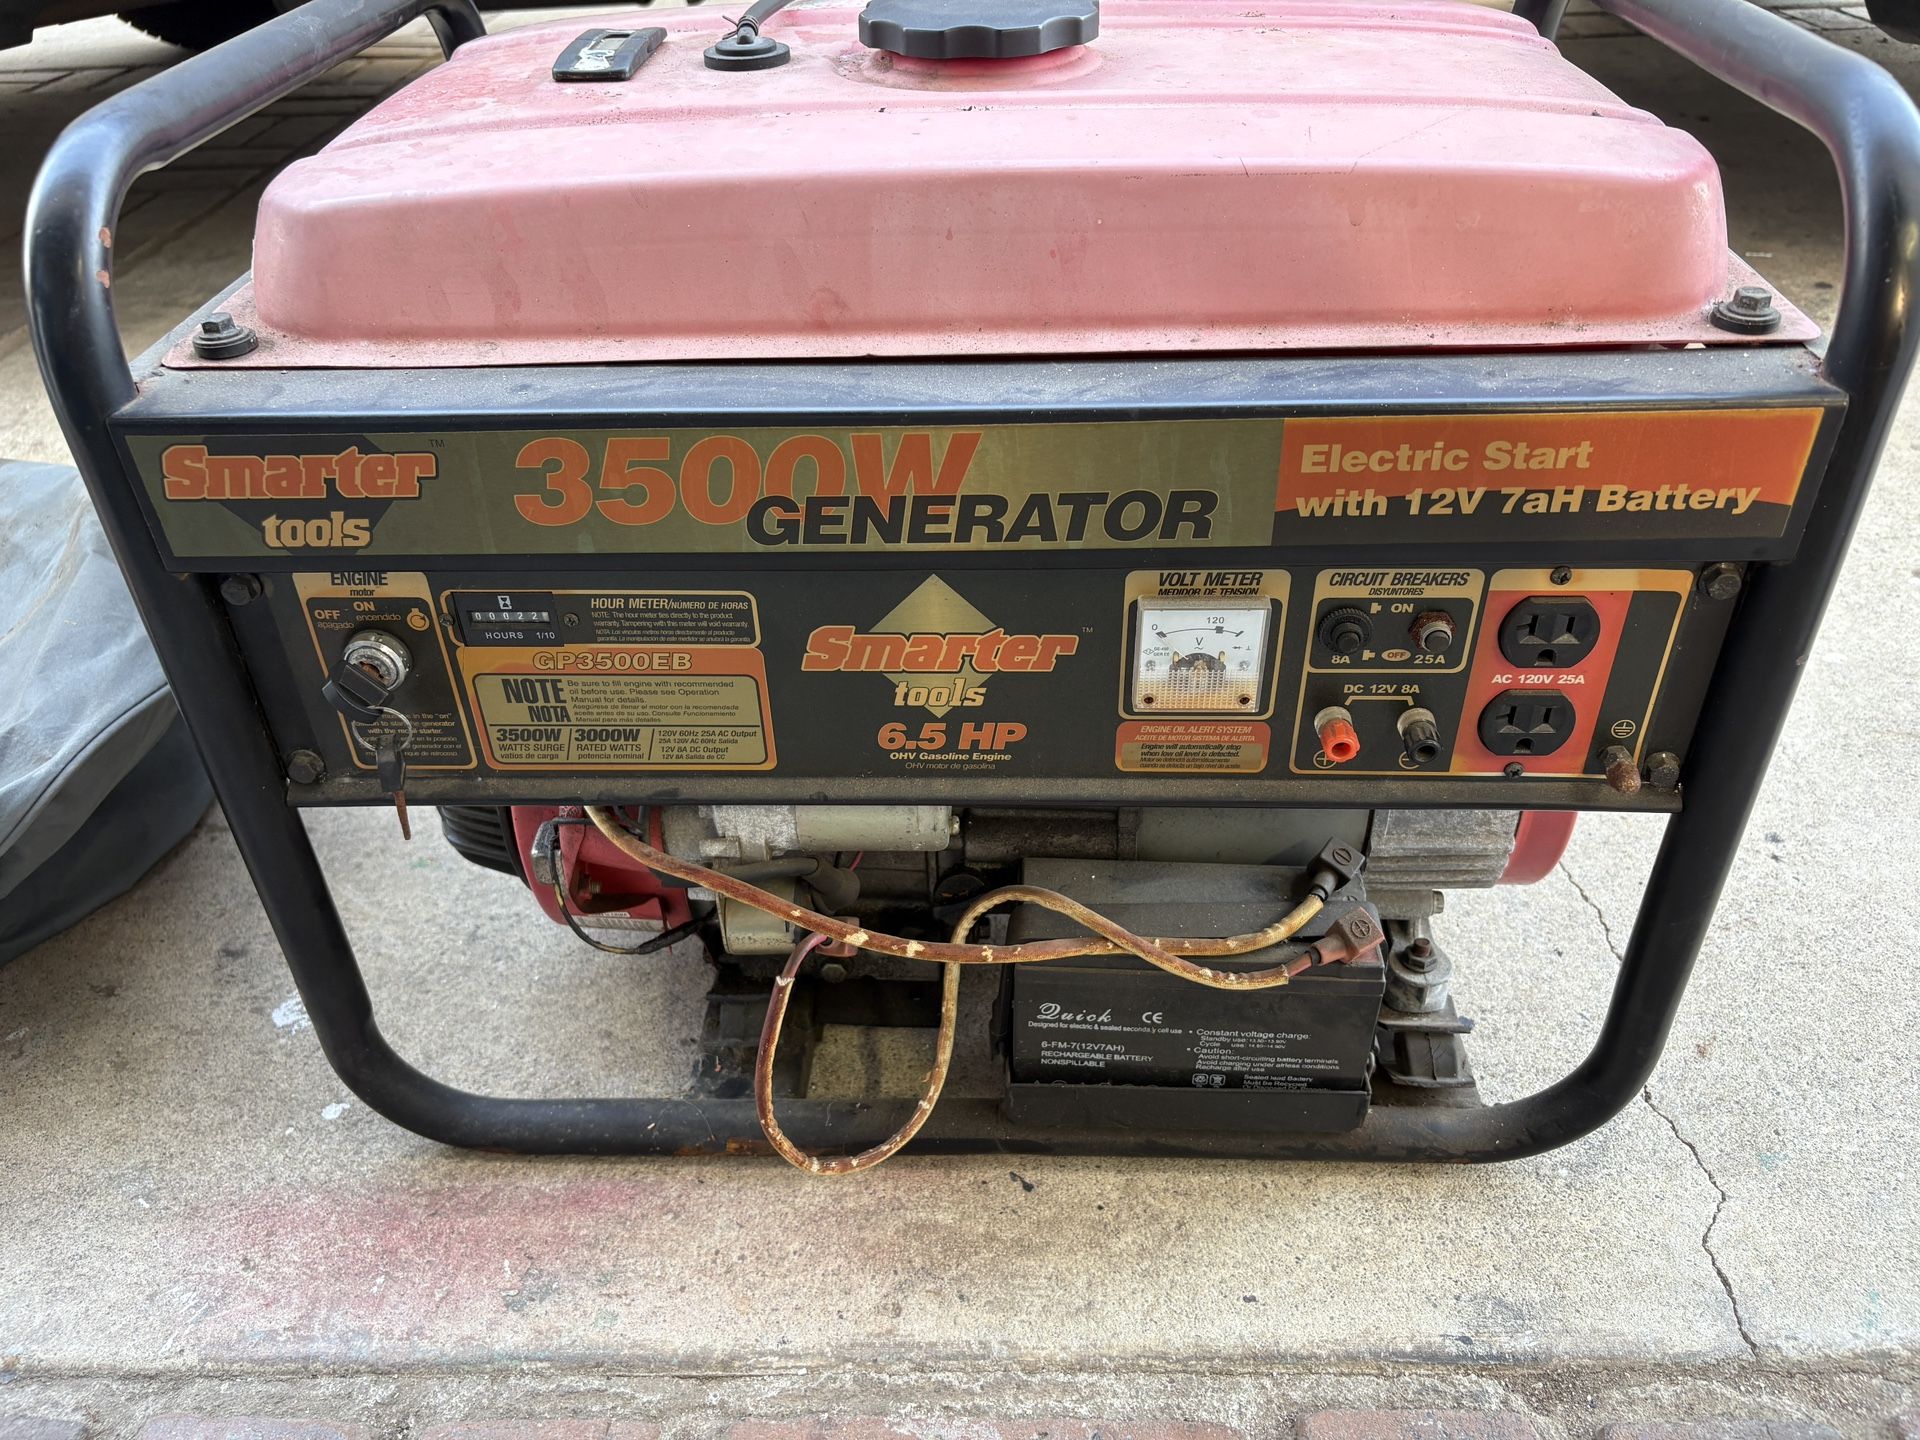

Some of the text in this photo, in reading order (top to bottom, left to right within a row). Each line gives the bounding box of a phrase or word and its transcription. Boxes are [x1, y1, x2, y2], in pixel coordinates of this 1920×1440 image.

[1301, 440, 1593, 473] Electric Start
[162, 445, 437, 500] Smarter
[514, 432, 982, 526] 3500W
[1296, 483, 1761, 518] with 12V 7aH Battery
[746, 489, 1219, 546] GENERATOR
[262, 511, 371, 548] tools
[331, 571, 388, 586] ENGINE
[1159, 571, 1264, 586] VOLT METER
[1329, 572, 1470, 587] CIRCUIT BREAKERS
[350, 588, 375, 597] motor
[1158, 587, 1259, 596] MEDIDOR DE TENSION
[1368, 587, 1425, 596] DISYUNTORES
[353, 601, 376, 612] ON
[591, 598, 625, 609] HOUR
[708, 601, 719, 609] DE
[721, 601, 749, 610] HORAS
[1391, 603, 1414, 613] ON
[314, 609, 340, 620] OFF
[356, 612, 401, 622] encendido
[1206, 616, 1225, 624] 120
[317, 621, 354, 630] apagado
[1151, 623, 1158, 631] 0
[485, 631, 556, 640] HOURS 1/10
[1195, 636, 1204, 646] V
[800, 625, 1079, 672] Smarter
[1331, 655, 1350, 664] 8A
[1387, 651, 1406, 659] OFF
[1413, 654, 1445, 664] 25A
[533, 651, 692, 671] GP3500EB
[1491, 674, 1585, 684] AC 120V 25A
[501, 678, 567, 704] NOTE
[678, 688, 720, 697] Operation
[894, 677, 987, 707] tools
[1343, 684, 1420, 693] DC 12V 8A
[527, 705, 571, 723] NOTA
[731, 730, 757, 738] Output
[1141, 725, 1252, 734] ENGINE OIL ALERT SYSTEM
[496, 728, 563, 742] 3500W
[574, 728, 640, 742] 3000W
[877, 722, 1028, 750] 6.5 HP
[498, 743, 565, 752] WATTS SURGE
[576, 743, 642, 751] RATED WATTS
[703, 746, 729, 754] Output
[1141, 743, 1165, 751] Engine
[1179, 743, 1225, 751] automatically
[500, 752, 559, 761] vatios de carga
[578, 752, 644, 760] potencia nominal
[890, 752, 1012, 761] OHV Gasoline Engine
[963, 762, 996, 771] gasolina
[1036, 1002, 1163, 1024] Quick CE
[1028, 1020, 1058, 1029] Designed
[1123, 1025, 1157, 1034] seconday
[1196, 1028, 1239, 1037] Constant
[1240, 1030, 1275, 1039] voltage
[1276, 1032, 1312, 1041] charge:
[1200, 1035, 1231, 1043] Standby
[1041, 1040, 1125, 1053] 6-FM-7(12V7AH)
[1200, 1040, 1220, 1048] Cycle
[1193, 1046, 1235, 1055] Caution:
[1041, 1050, 1154, 1062] RECHARGEABLE BATTERY
[1041, 1058, 1105, 1067] NONSPILLABLE
